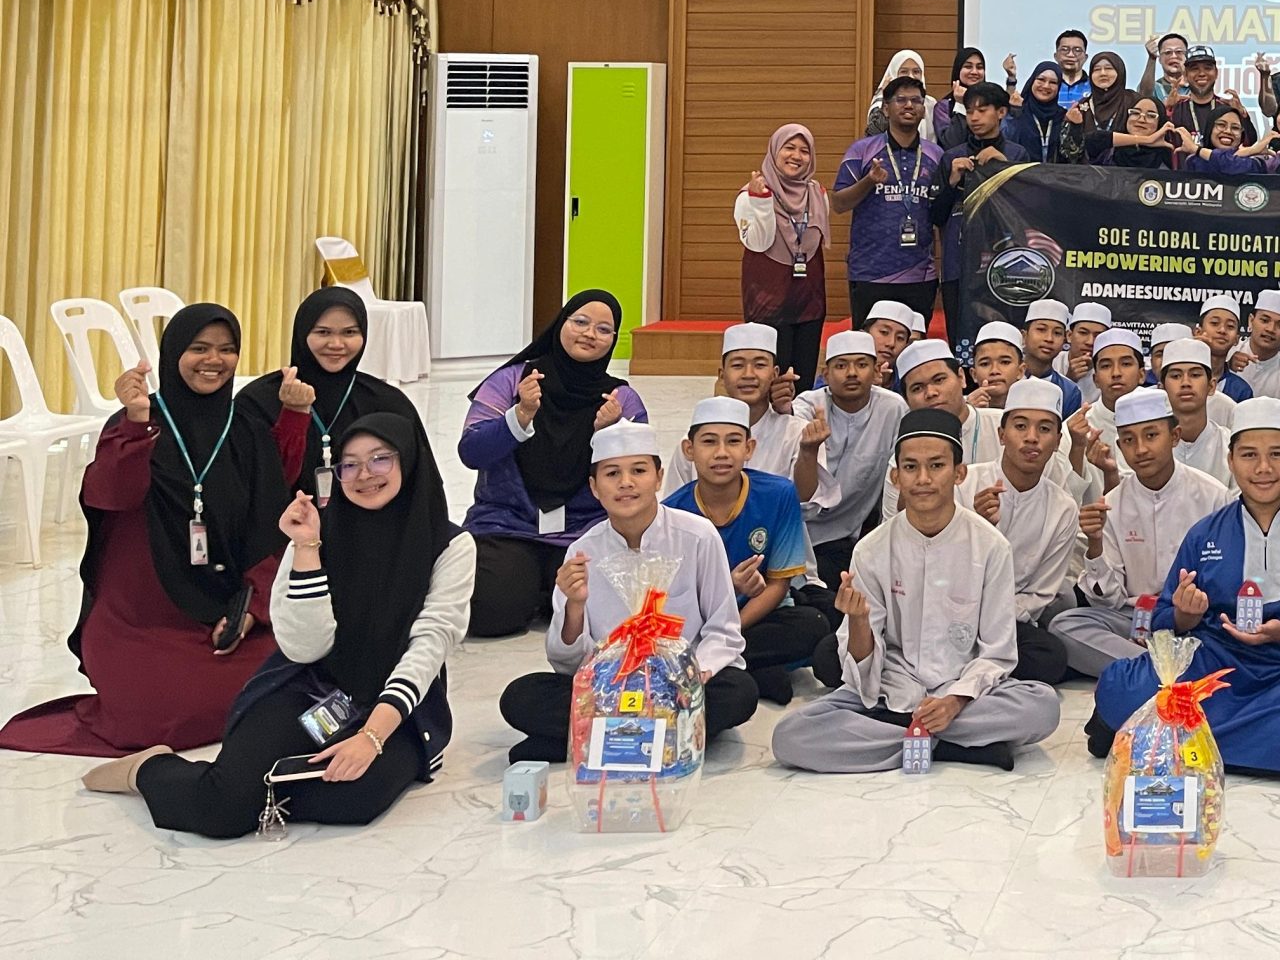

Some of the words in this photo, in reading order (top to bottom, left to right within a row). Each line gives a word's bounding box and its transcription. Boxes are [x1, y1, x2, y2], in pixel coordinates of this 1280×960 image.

[1165, 182, 1224, 201] UUM
[1098, 227, 1130, 246] SOE
[1138, 230, 1200, 250] GLOBAL
[1065, 250, 1196, 274] EMPOWERING
[1202, 258, 1268, 278] YOUNG
[627, 697, 636, 708] 2
[1191, 751, 1198, 762] 3
